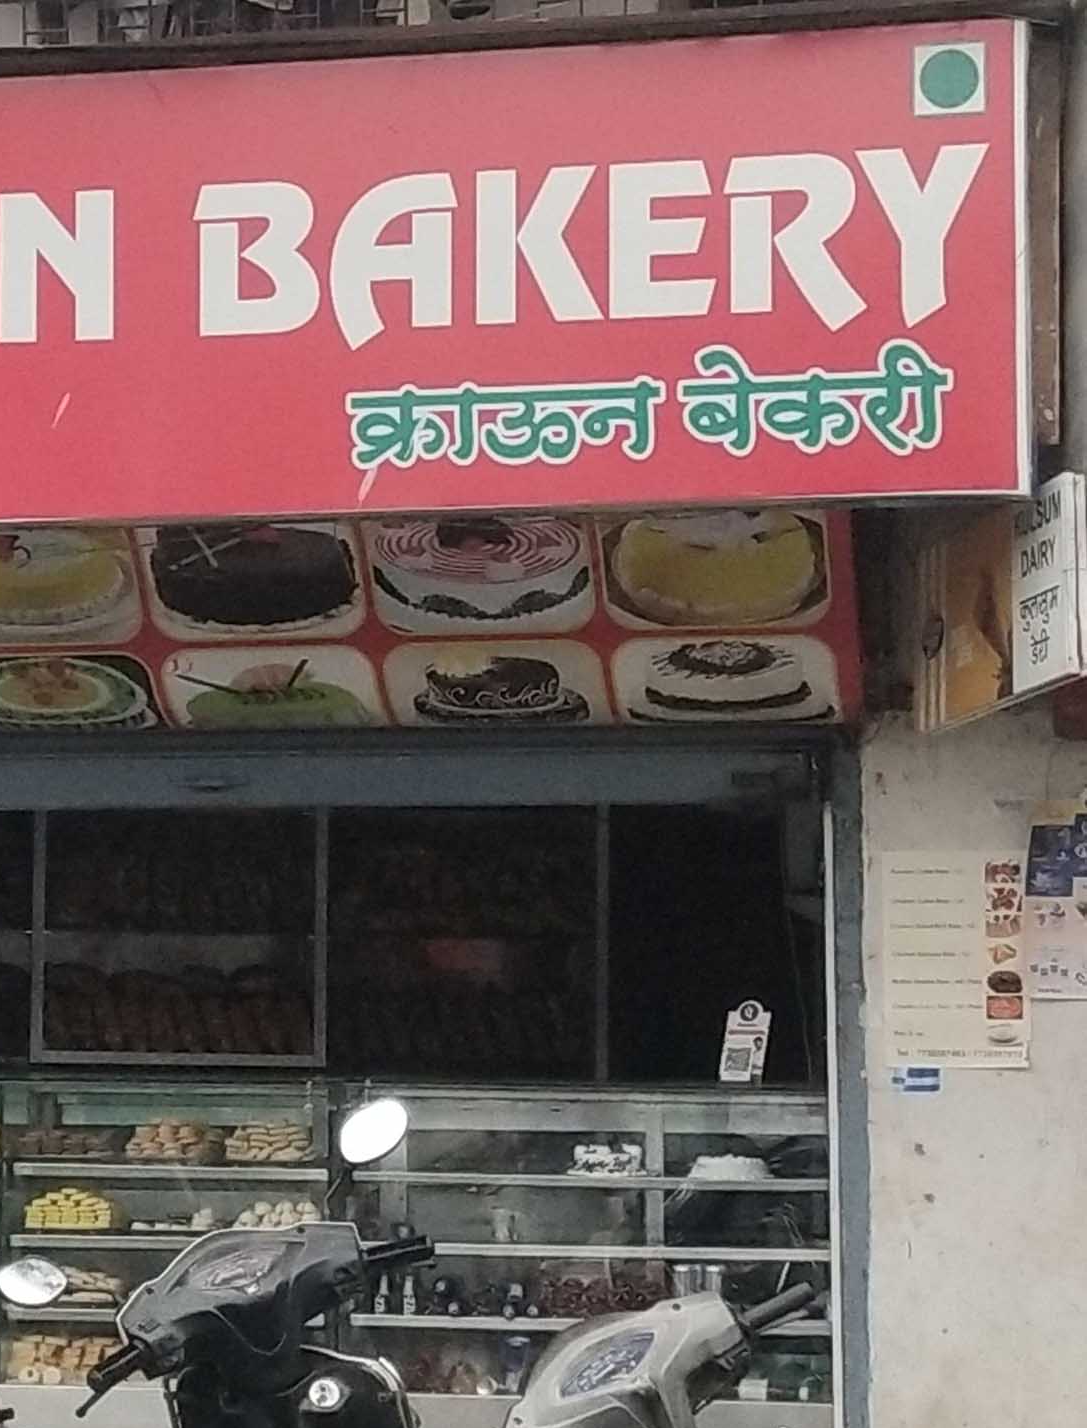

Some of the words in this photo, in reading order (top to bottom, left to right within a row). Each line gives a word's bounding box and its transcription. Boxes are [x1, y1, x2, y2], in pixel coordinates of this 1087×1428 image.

[193, 143, 989, 351] BAKERY
[348, 379, 662, 462] क्राऊन
[681, 342, 950, 453] बेकरी
[1021, 536, 1056, 578] DAIRY
